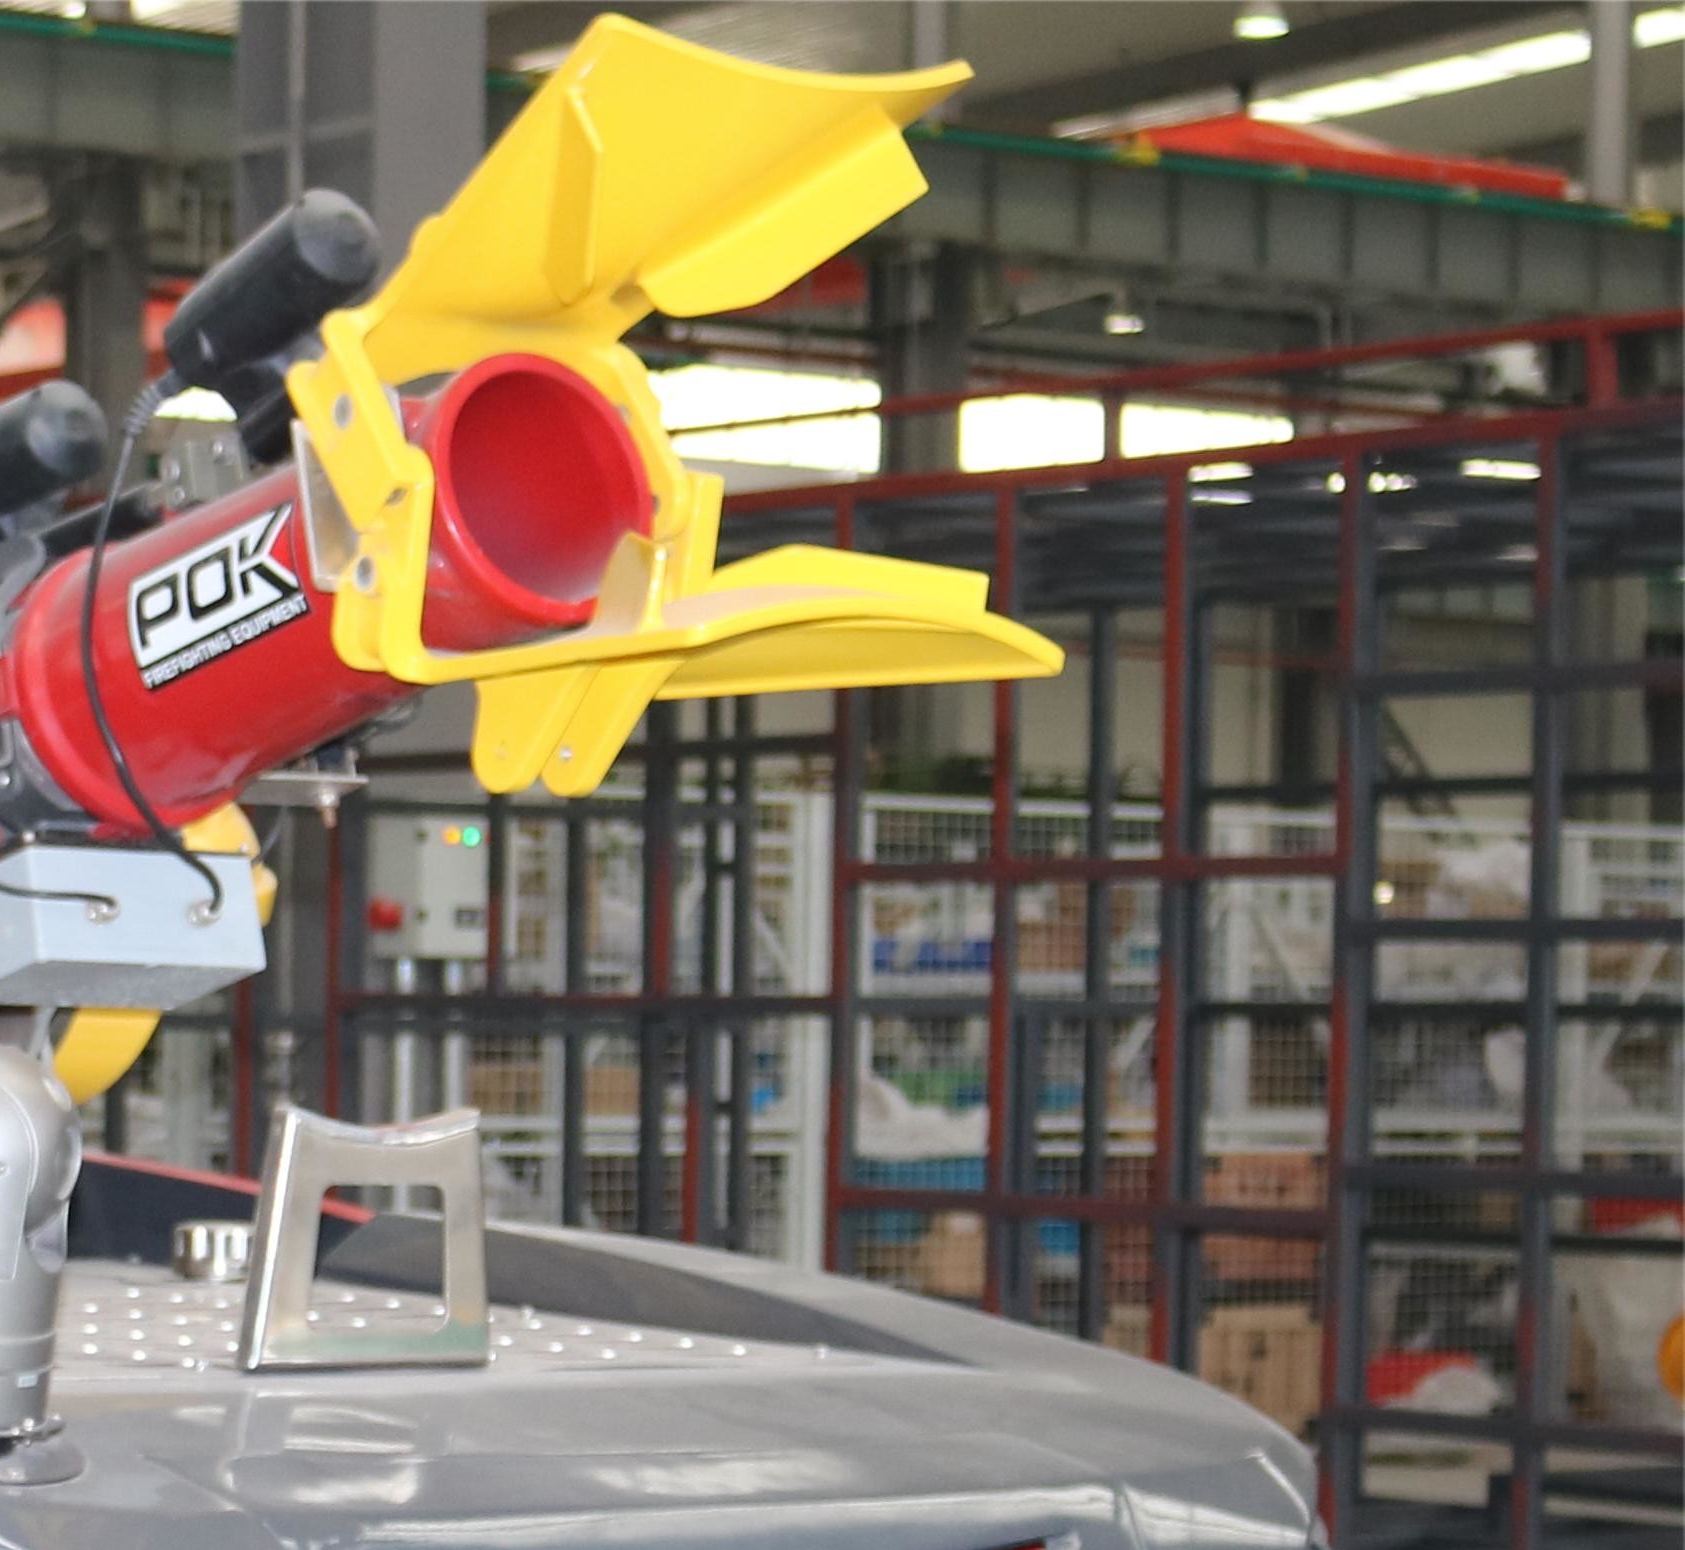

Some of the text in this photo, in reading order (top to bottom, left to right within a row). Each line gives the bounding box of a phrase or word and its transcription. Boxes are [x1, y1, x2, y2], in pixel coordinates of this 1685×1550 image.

[136, 503, 299, 648] POK
[145, 595, 308, 688] FIREFIGHTING EQUIPMENT
